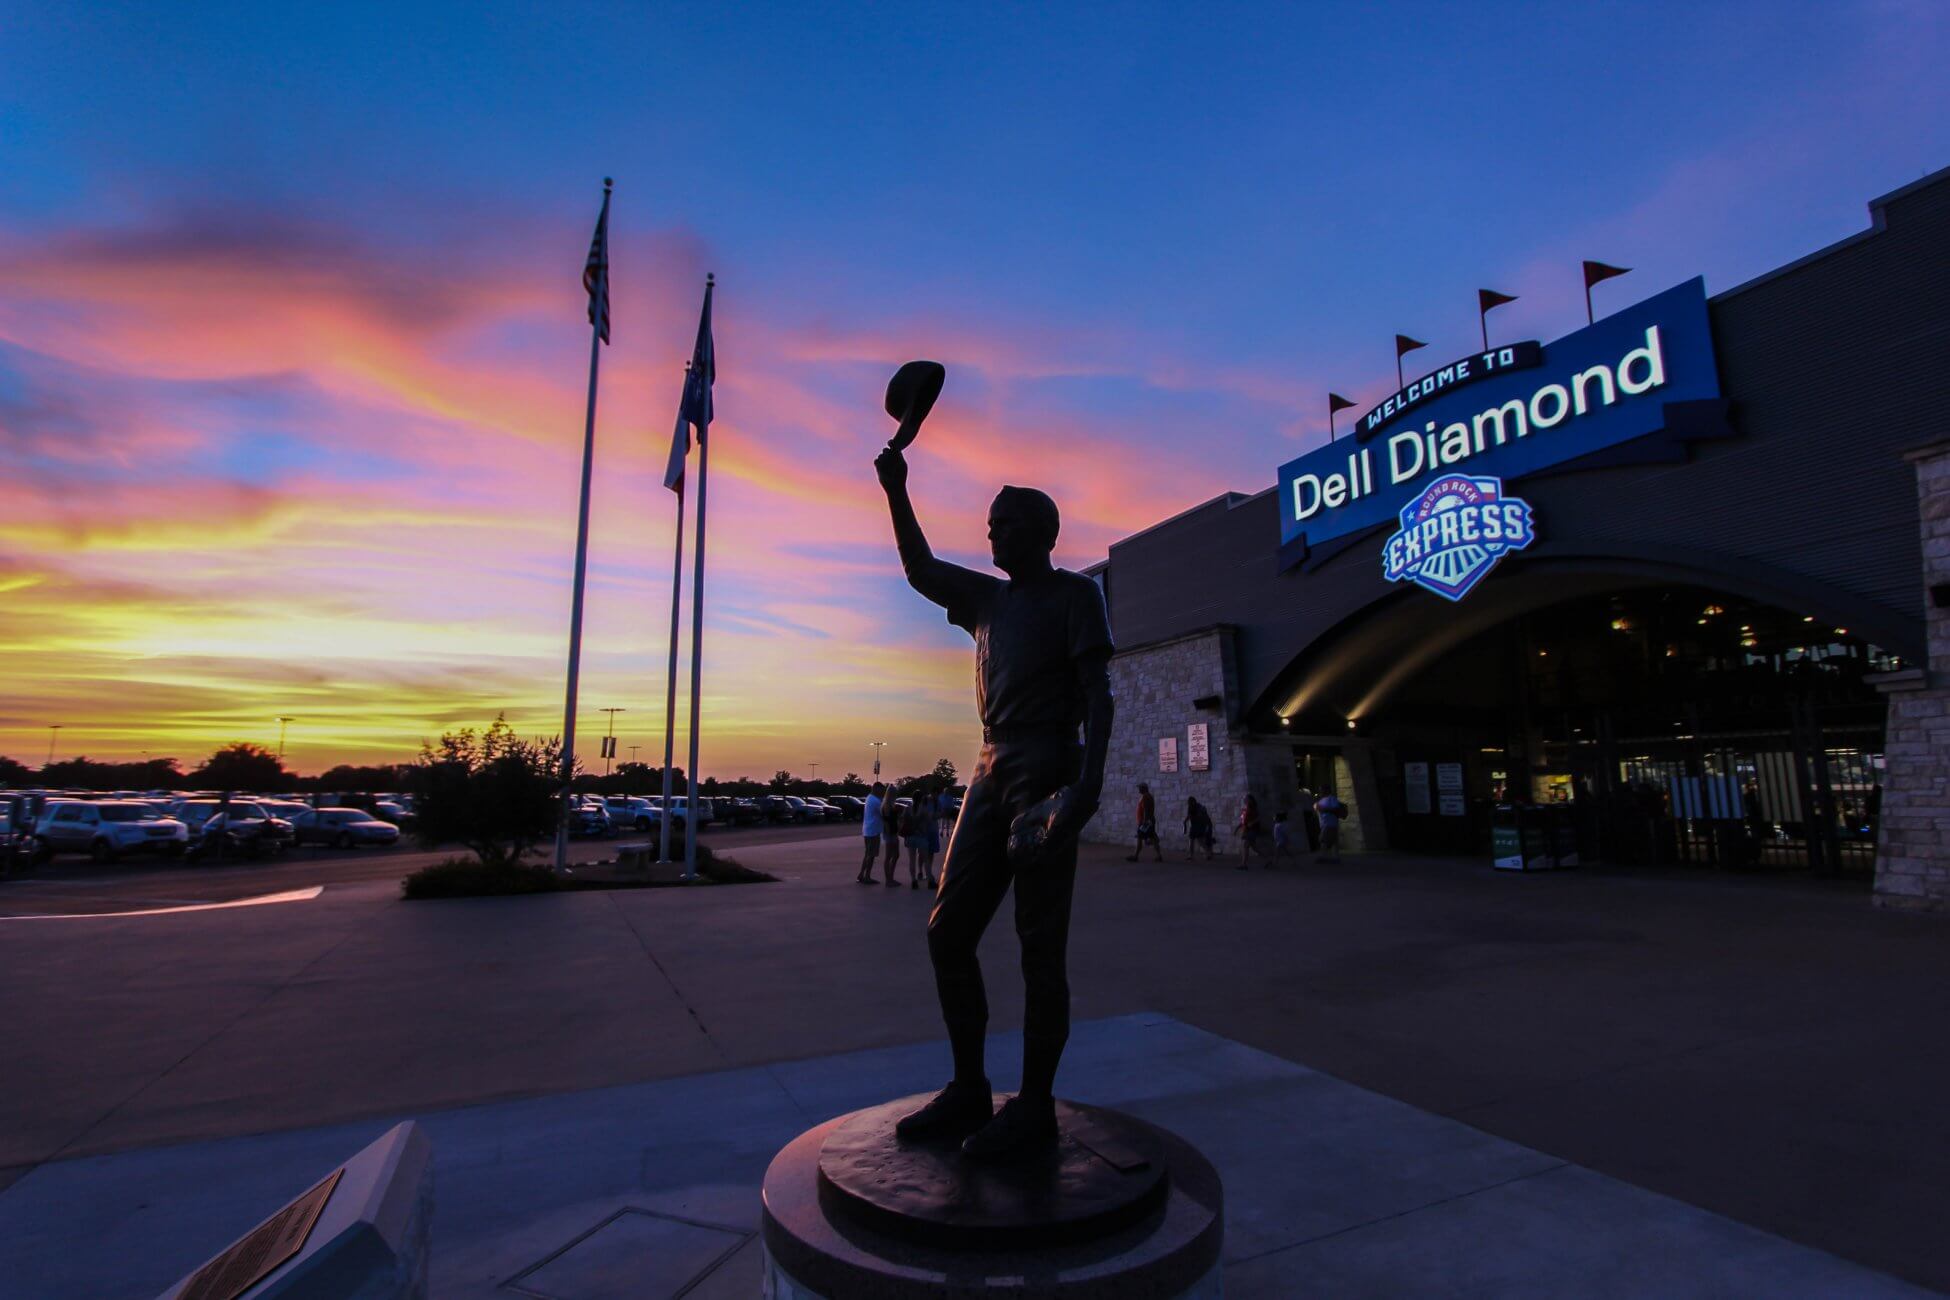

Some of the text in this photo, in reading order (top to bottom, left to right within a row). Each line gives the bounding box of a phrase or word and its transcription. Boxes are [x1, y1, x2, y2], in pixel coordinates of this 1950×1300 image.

[1293, 325, 1665, 521] Dell Diamond
[1367, 348, 1514, 430] WELCOME TO
[1420, 481, 1478, 517] ROUND ROCK
[1389, 504, 1524, 573] EXPRESS
